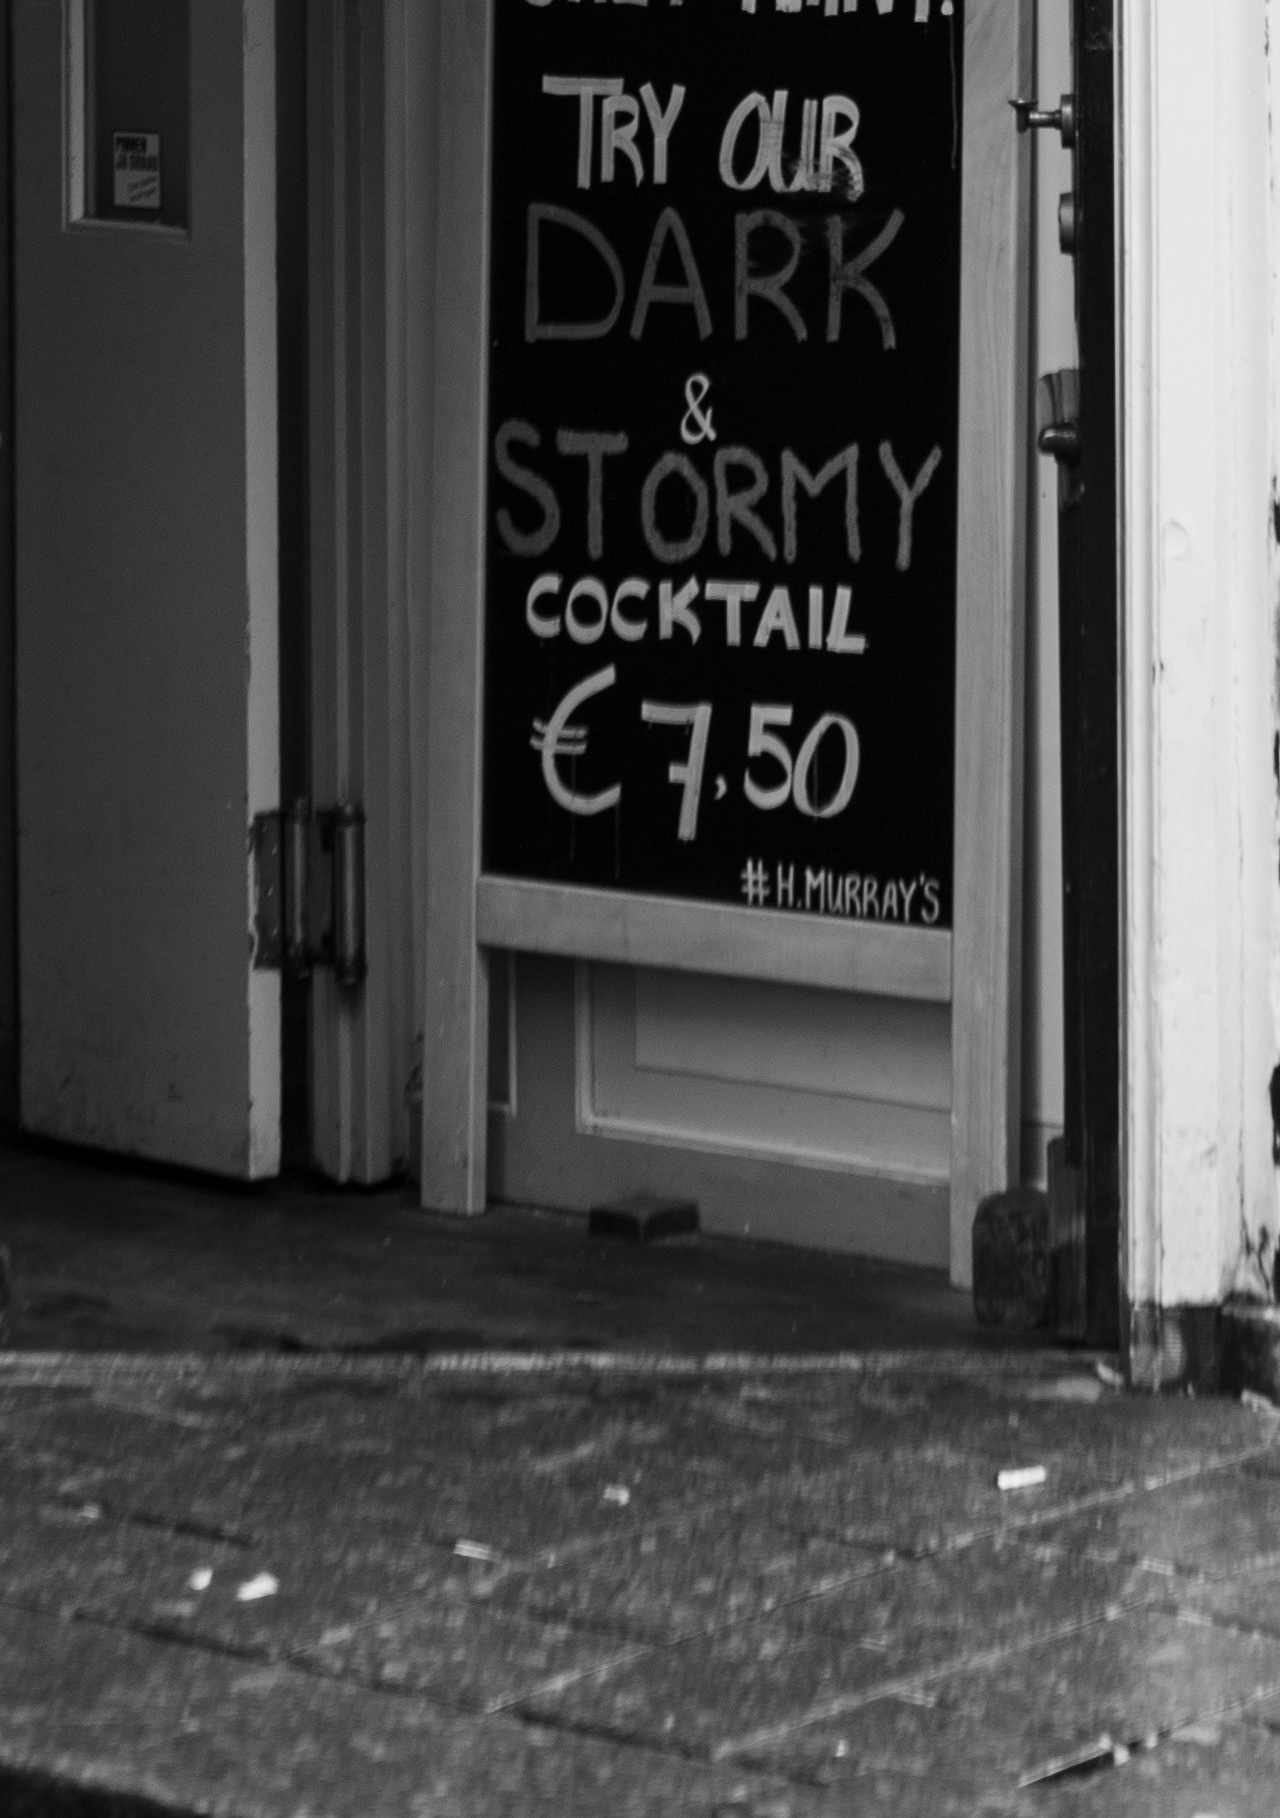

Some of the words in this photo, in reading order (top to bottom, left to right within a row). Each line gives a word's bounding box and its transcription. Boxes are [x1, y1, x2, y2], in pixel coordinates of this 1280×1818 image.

[542, 75, 686, 190] TRY
[719, 90, 865, 201] OUR
[524, 203, 906, 351] DARK
[680, 373, 717, 445] &
[495, 417, 943, 571] STORMY
[526, 573, 868, 654] COCKTAIL
[530, 663, 622, 816] €
